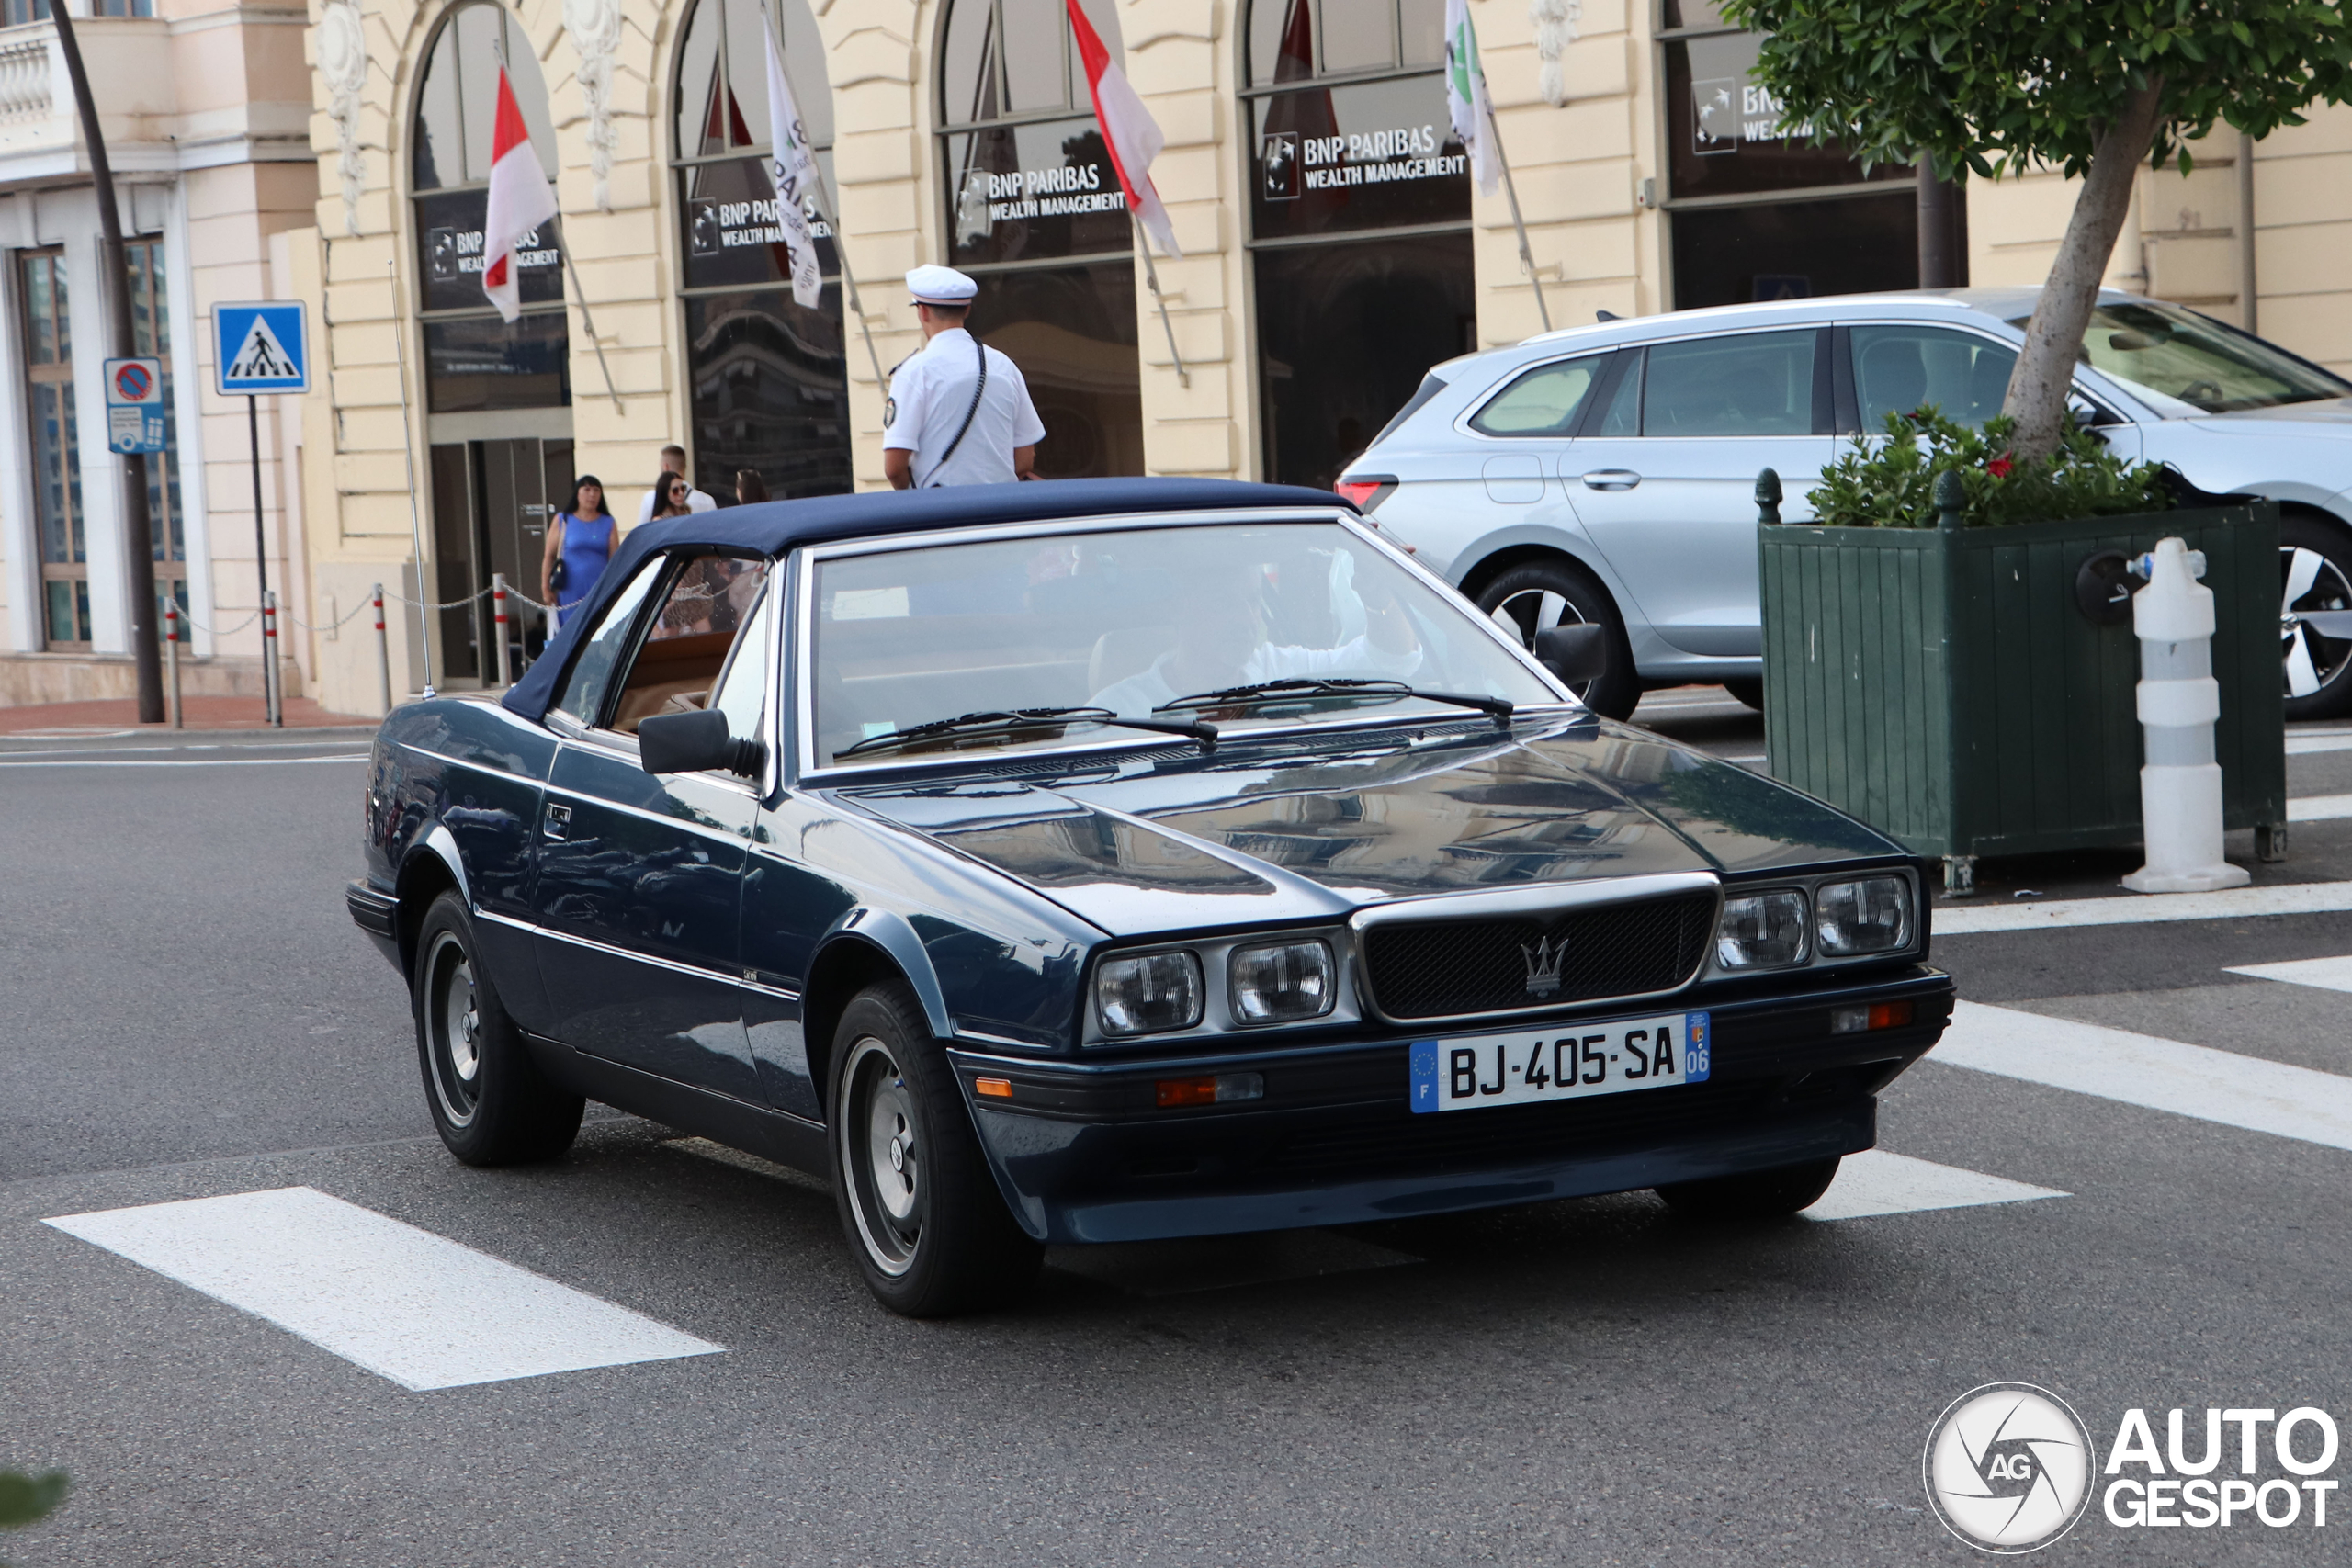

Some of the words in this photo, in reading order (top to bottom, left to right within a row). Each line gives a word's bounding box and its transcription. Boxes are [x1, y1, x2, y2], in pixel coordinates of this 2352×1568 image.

[1304, 136, 1345, 165] BNP
[1349, 125, 1435, 160] PARIBAS
[989, 172, 1023, 199] BNP
[1026, 163, 1100, 195] PARIBAS
[1305, 166, 1363, 189] WEALTH
[1365, 154, 1466, 183] MANAGEMENT
[719, 202, 750, 227] BNP
[989, 198, 1038, 221] WEALTH
[1040, 191, 1125, 216] MANAGEMENT
[456, 231, 483, 254] BNP
[721, 227, 763, 247] WEALTH
[1450, 1026, 1675, 1099] BJ-405-SA
[1687, 1049, 1709, 1074] 06
[1420, 1084, 1429, 1099] F
